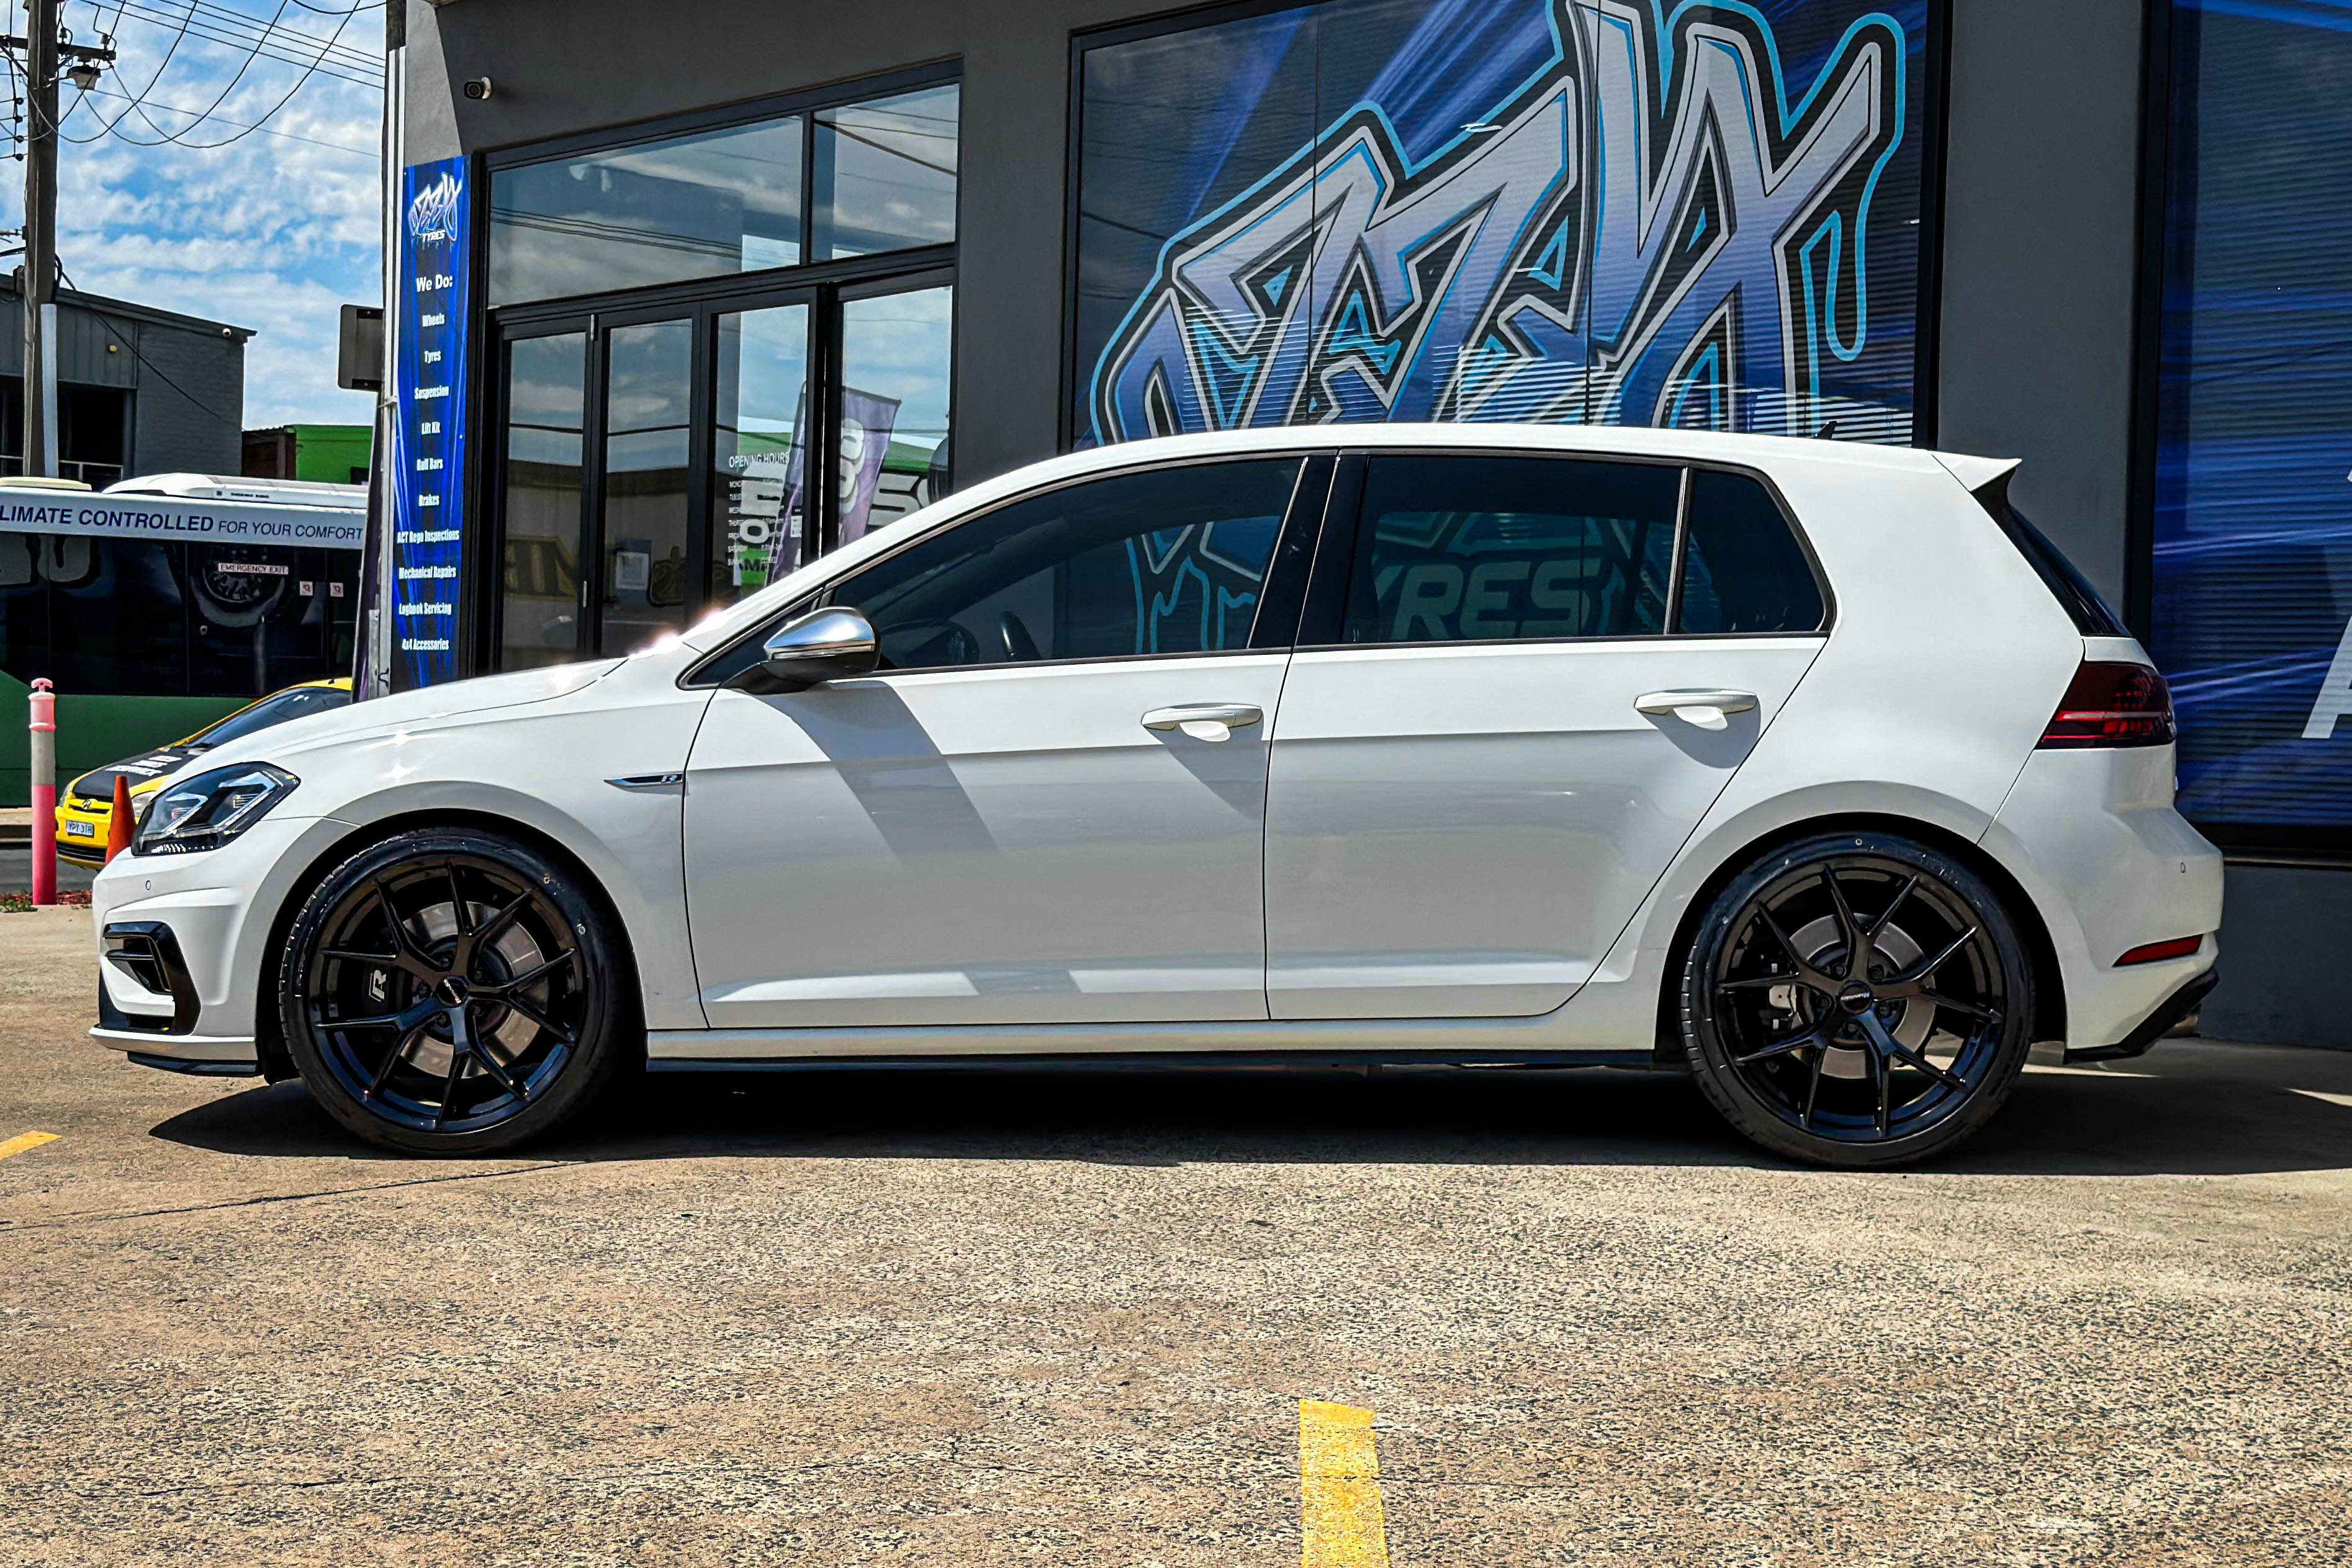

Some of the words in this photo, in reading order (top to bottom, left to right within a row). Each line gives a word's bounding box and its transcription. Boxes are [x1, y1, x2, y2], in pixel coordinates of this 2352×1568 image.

[422, 230, 446, 242] TYRES
[416, 276, 432, 292] We
[435, 274, 453, 290] Do:
[422, 312, 445, 327] Wheels
[424, 350, 441, 363] Tyres
[415, 385, 449, 400] Suspension
[421, 423, 430, 435] Lift
[431, 421, 440, 434] Kit
[417, 459, 428, 471] Bull
[429, 458, 443, 471] Bars
[729, 454, 762, 468] OPENING
[764, 452, 790, 465] HOURS
[418, 495, 439, 507] Brakes
[79, 509, 214, 531] CONTROLLED
[219, 521, 248, 533] FOR
[253, 522, 291, 536] YOUR
[295, 525, 363, 539] COMFORT
[397, 531, 408, 544] ACT
[409, 530, 424, 544] Rego
[425, 528, 459, 542] Inspections
[220, 564, 267, 573] EMERGENCY
[399, 567, 433, 580] Mechanical
[433, 565, 457, 578] Repairs
[399, 603, 423, 616] Logbook
[424, 602, 452, 615] Servicing
[402, 639, 412, 651] 4x4
[413, 638, 449, 651] Accessories
[660, 774, 677, 783] R
